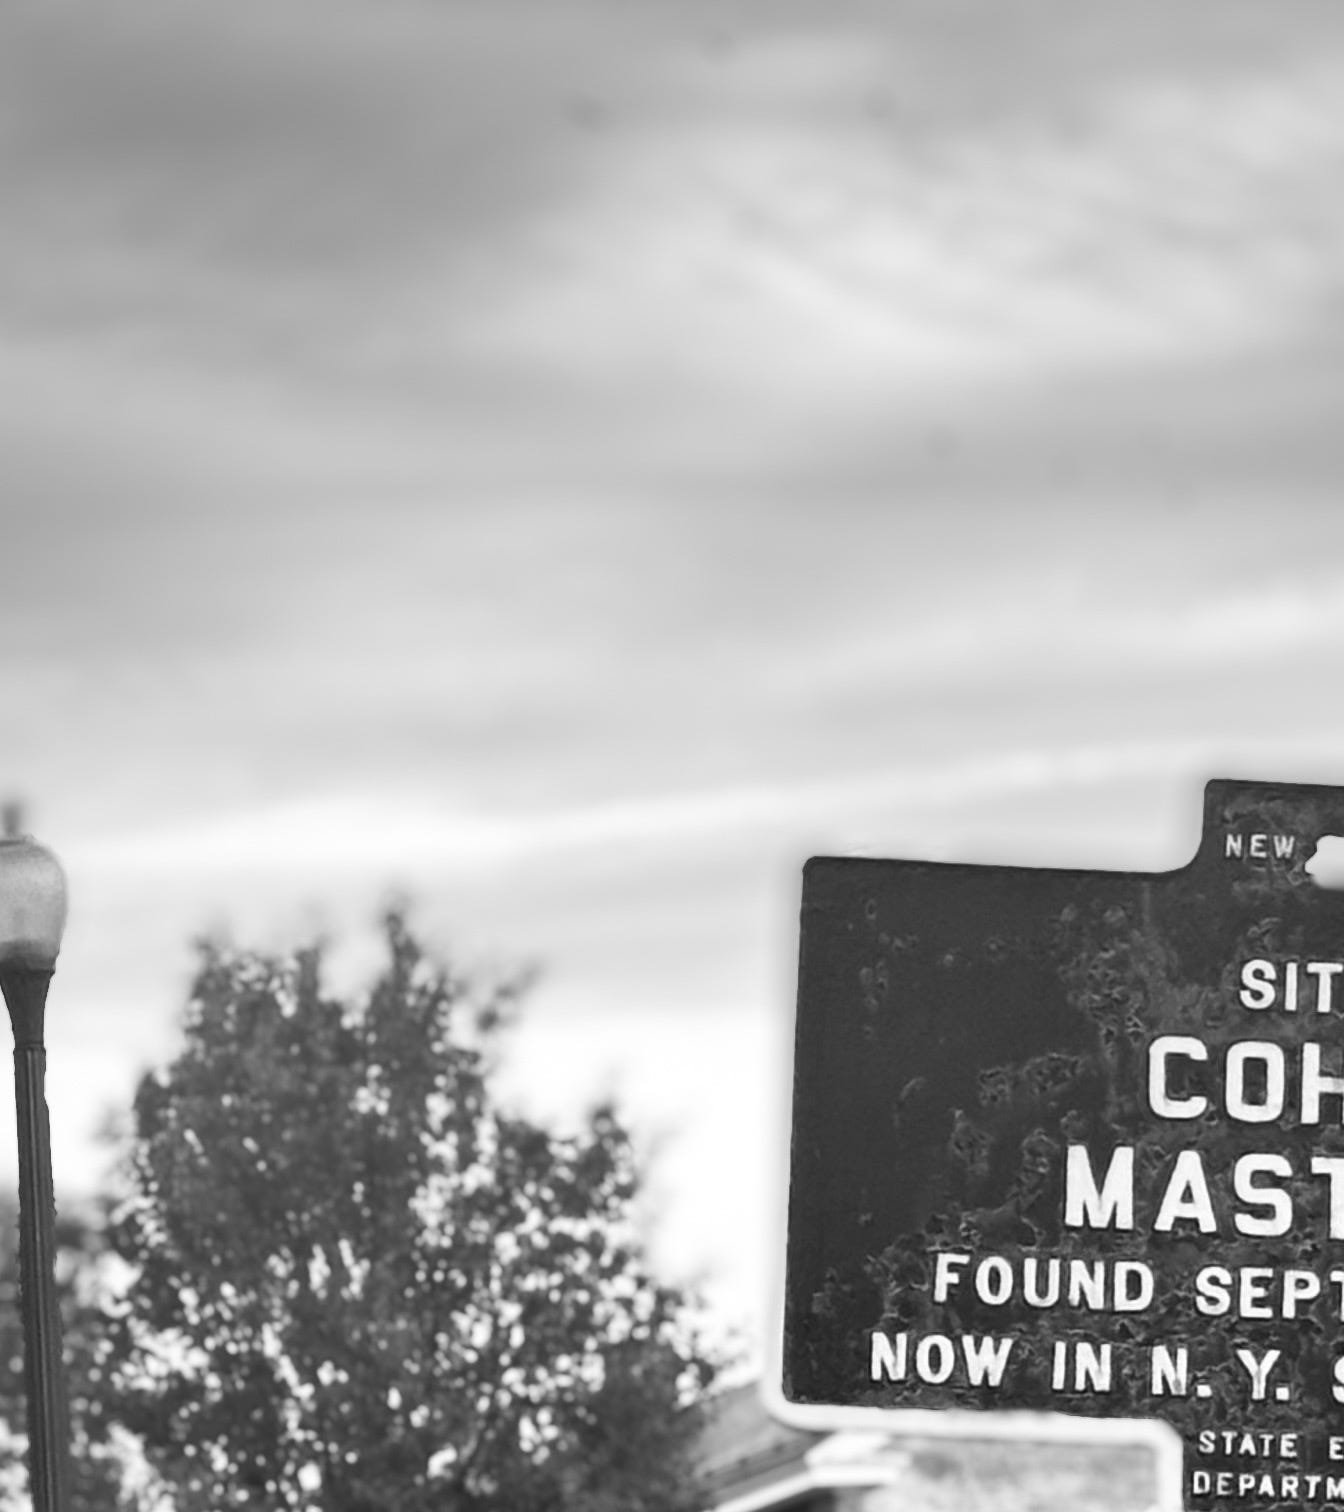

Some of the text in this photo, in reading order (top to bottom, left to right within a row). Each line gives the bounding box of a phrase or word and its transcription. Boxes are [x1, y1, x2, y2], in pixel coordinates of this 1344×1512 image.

[1226, 834, 1295, 858] NEW
[934, 1253, 1154, 1311] FOUND
[871, 1332, 1013, 1386] NOW
[1052, 1340, 1112, 1391] IN
[1151, 1345, 1213, 1397] N.
[1237, 1349, 1290, 1401] Y.
[1199, 1430, 1298, 1458] STATE
